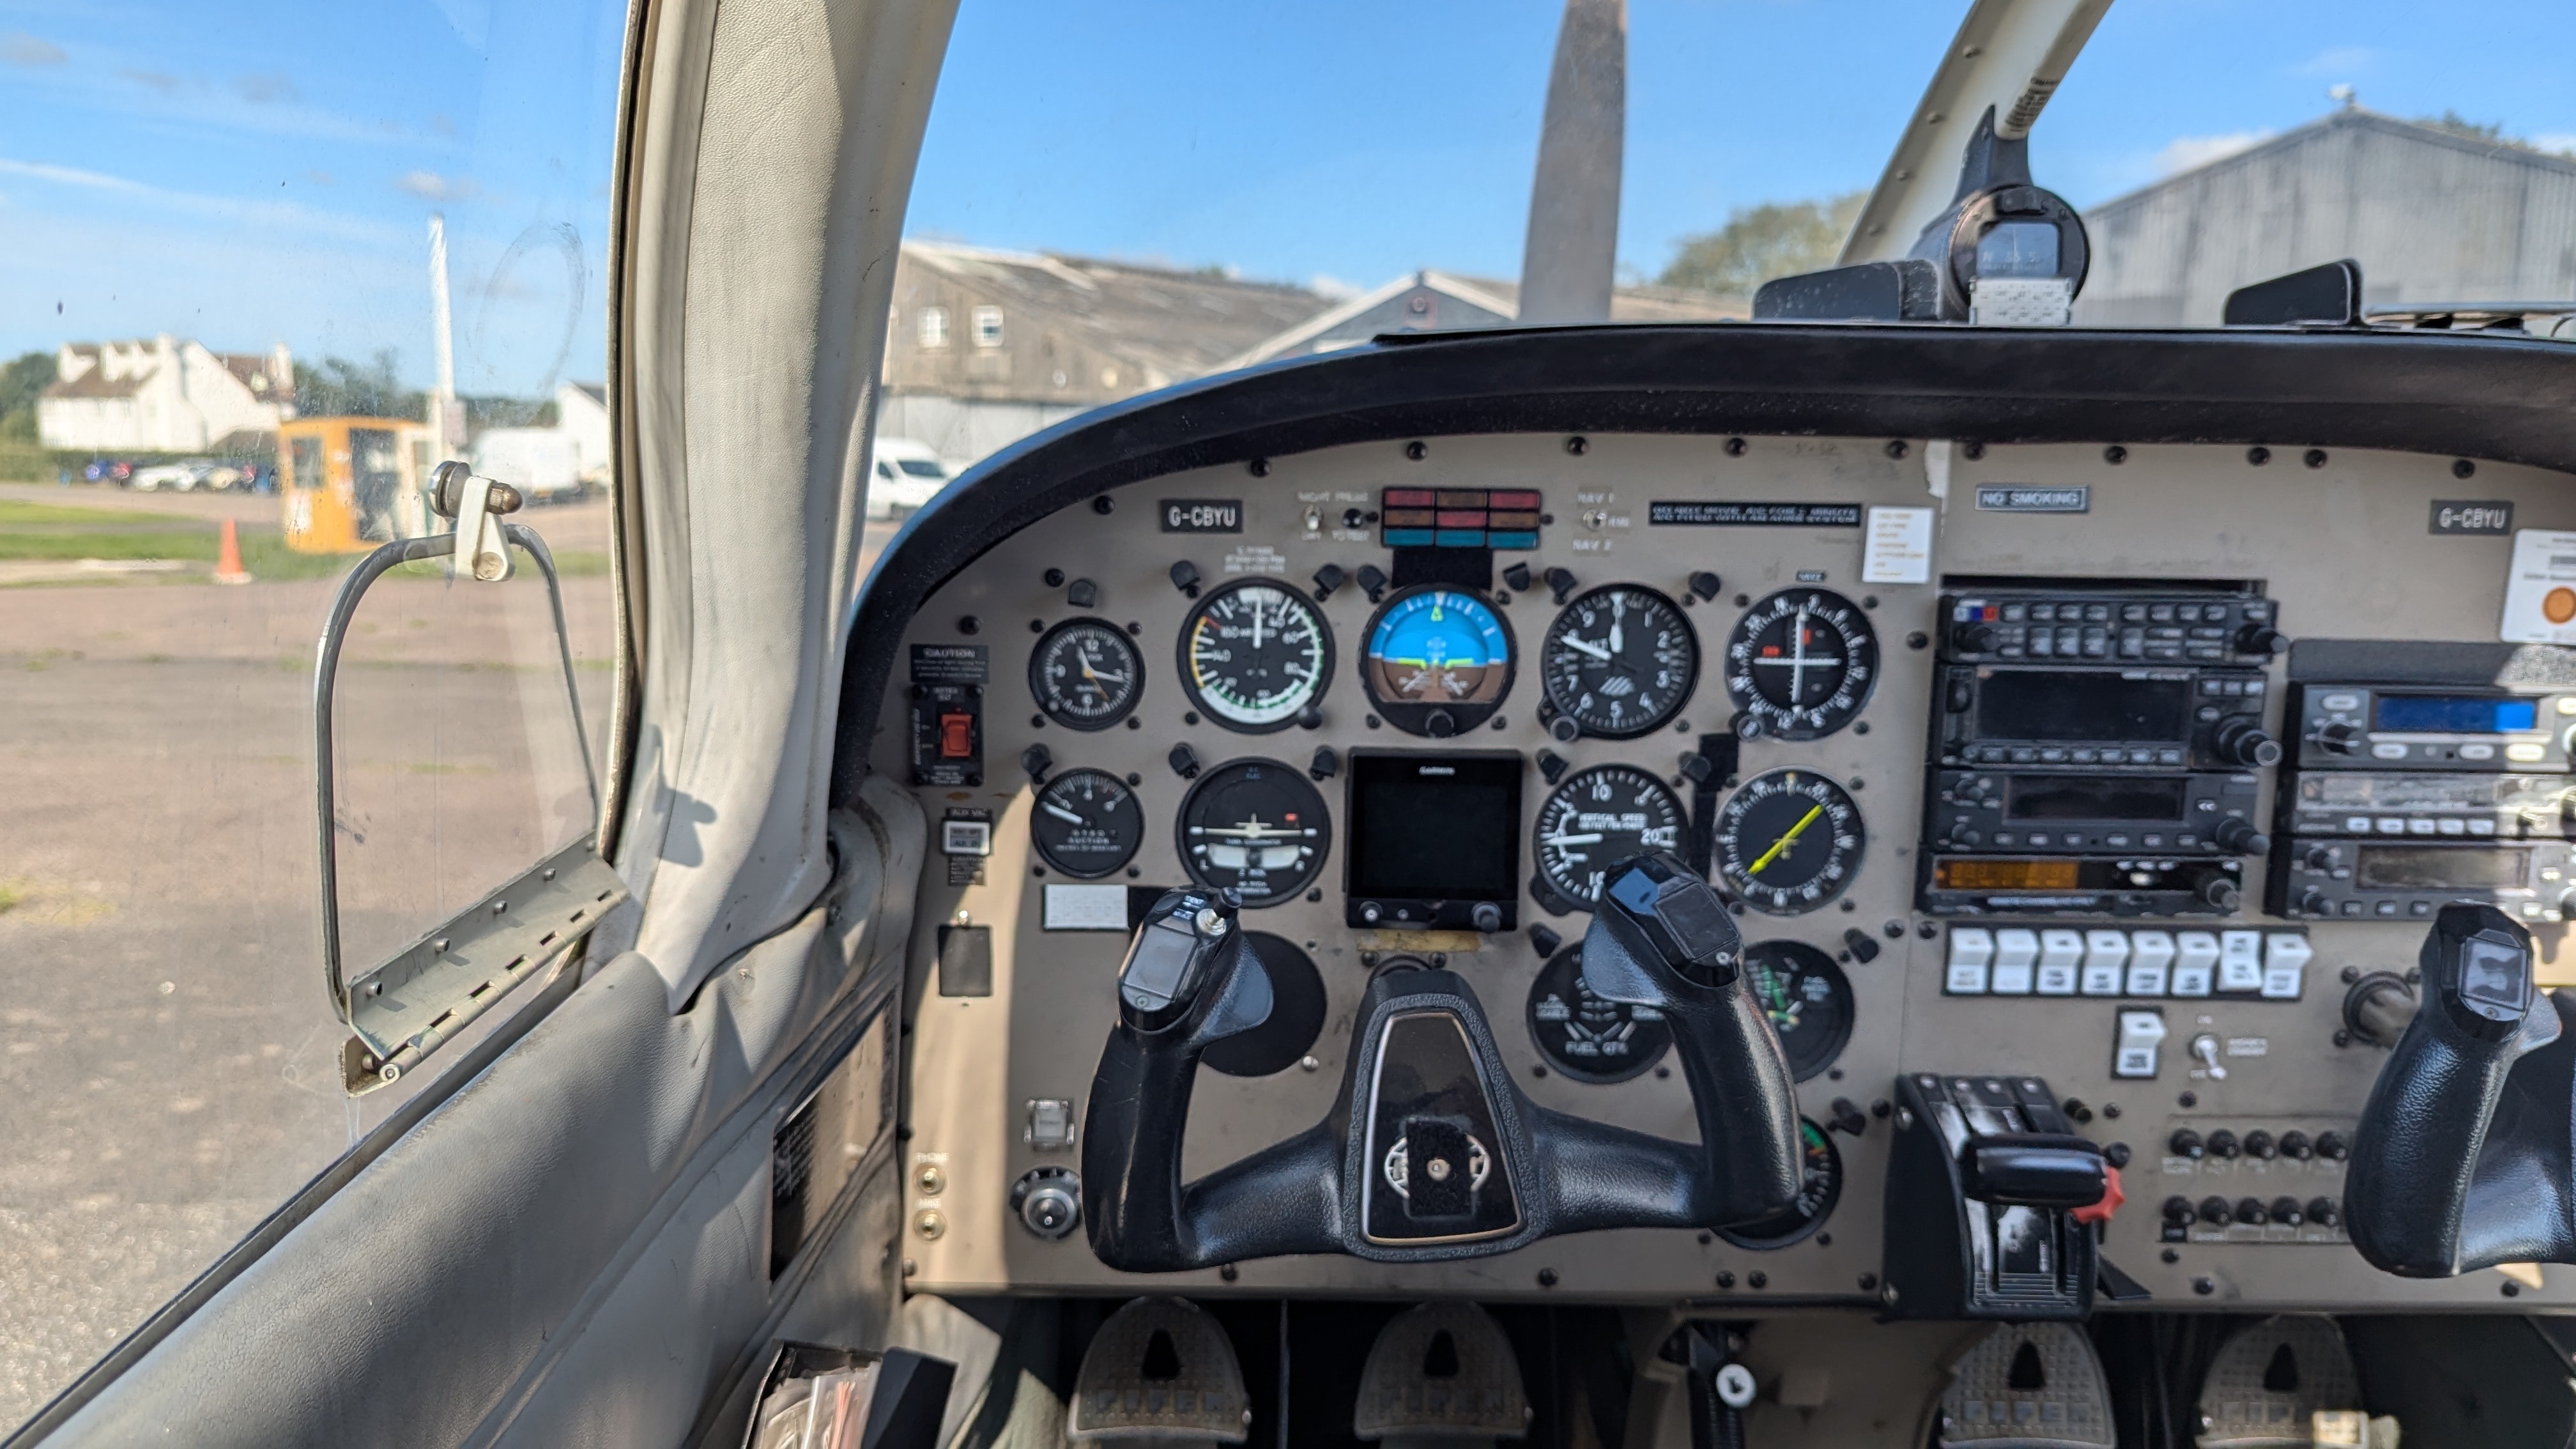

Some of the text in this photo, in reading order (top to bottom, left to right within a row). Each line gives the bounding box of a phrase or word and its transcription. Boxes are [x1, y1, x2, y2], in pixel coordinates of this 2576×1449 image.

[1982, 491, 2080, 506] NO SMOKING
[1168, 505, 1236, 527] G-CBYU
[2438, 507, 2506, 528] G-CBYU
[1582, 610, 1595, 627] 9
[1657, 630, 1671, 648] 2
[923, 648, 976, 658] CAUTION
[1567, 674, 1579, 693] 7
[1656, 670, 1670, 689] 3
[1610, 700, 1624, 719] 5
[1591, 784, 1613, 802] 10
[1578, 813, 1648, 822] VERTICAL SPEED
[1640, 827, 1660, 847] 20
